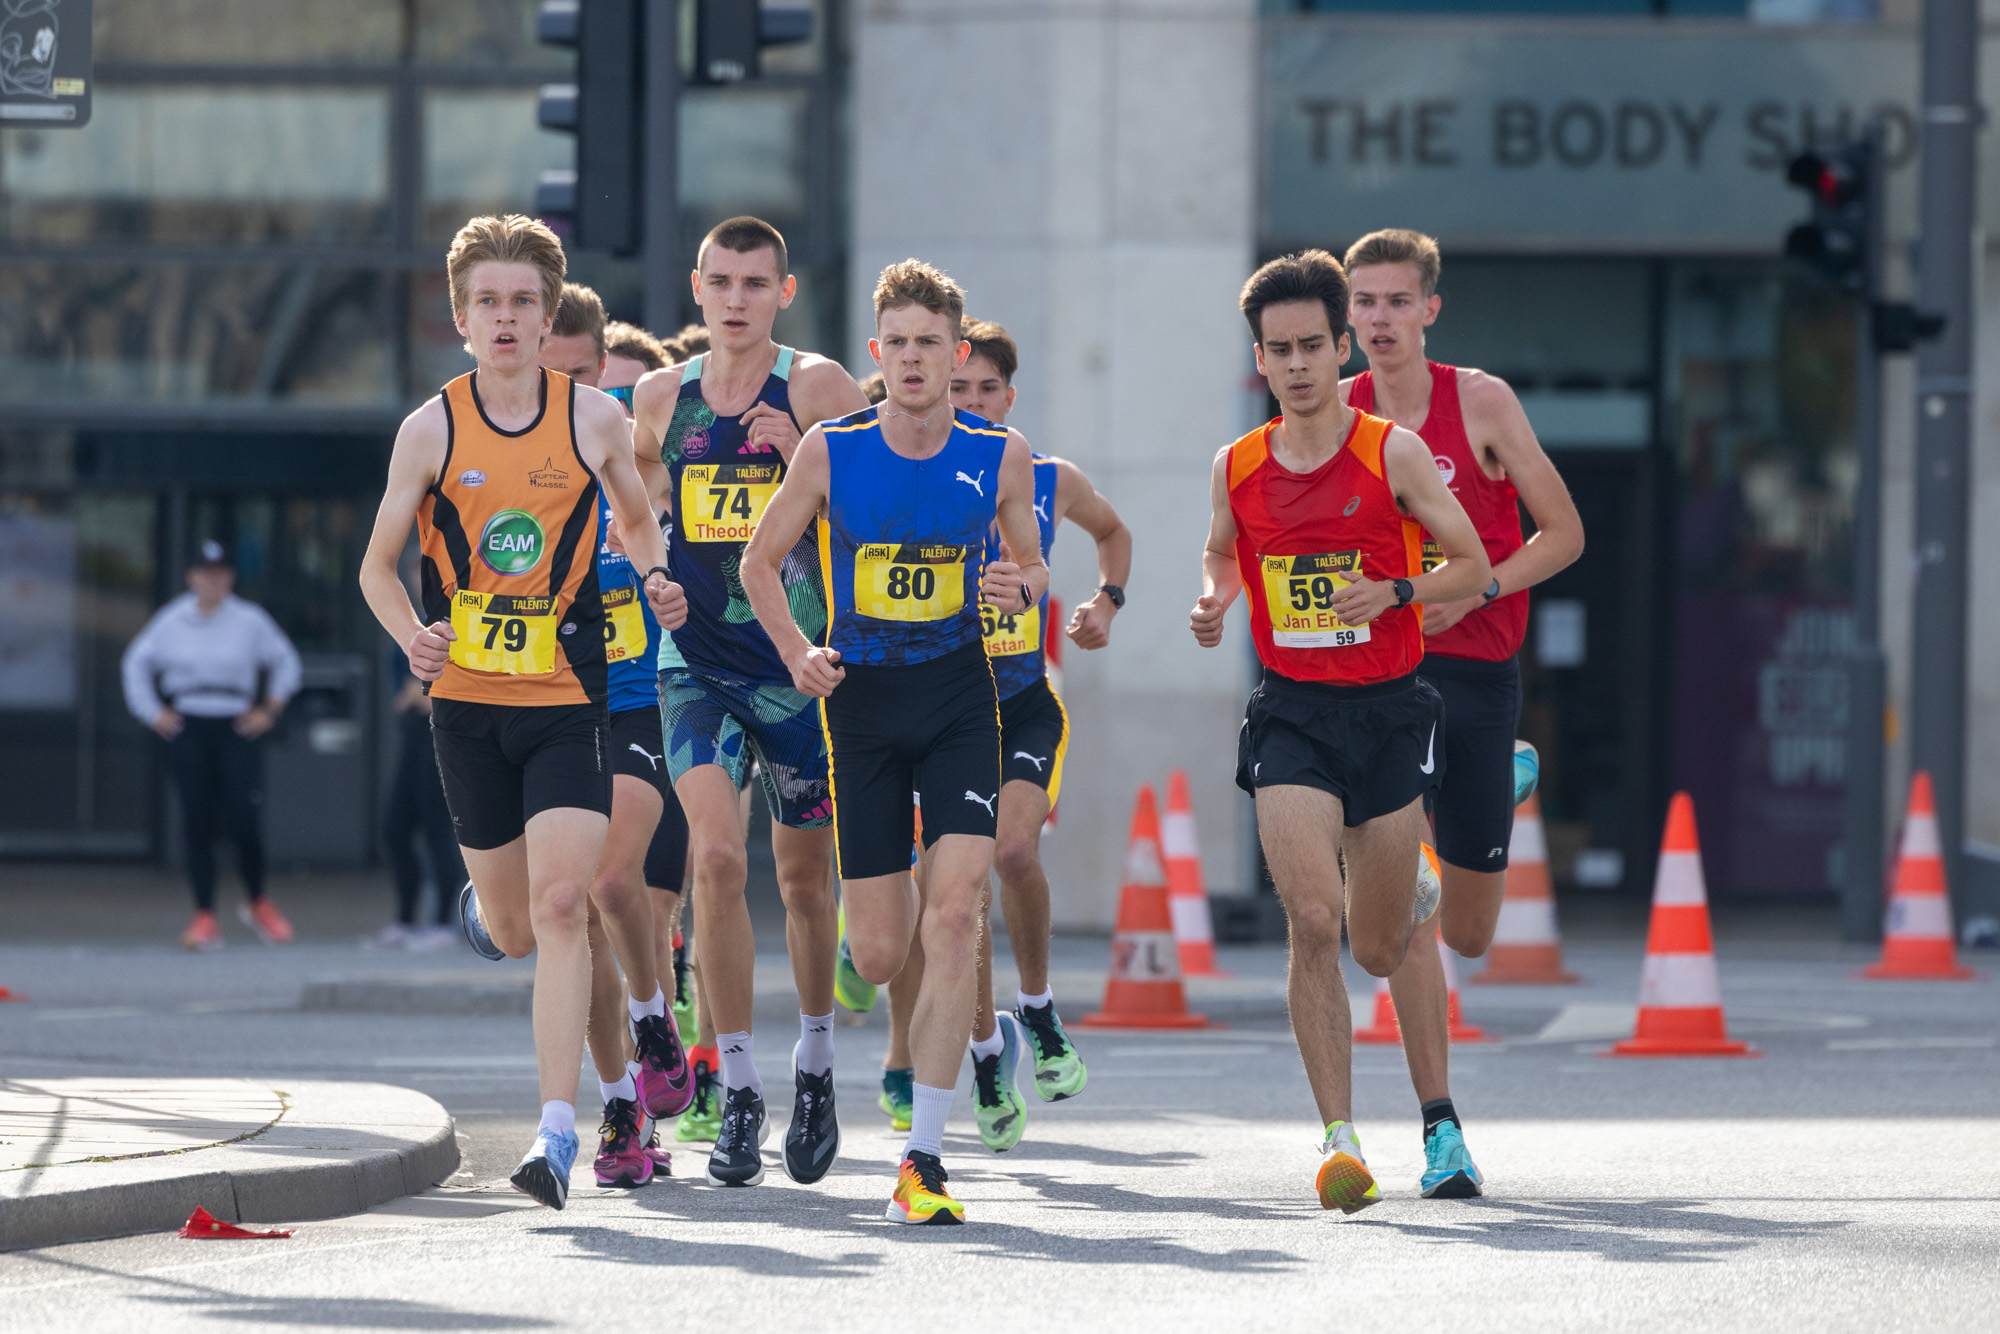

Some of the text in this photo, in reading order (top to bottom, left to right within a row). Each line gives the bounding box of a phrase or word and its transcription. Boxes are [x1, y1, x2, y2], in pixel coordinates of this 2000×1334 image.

[1301, 100, 1459, 167] THE
[1493, 100, 1722, 169] BODY
[736, 467, 771, 479] TALENTS
[709, 488, 752, 520] 74
[488, 533, 535, 552] EAM
[920, 548, 957, 559] TALENTS
[1314, 555, 1352, 568] TALENTS
[887, 566, 935, 600] 80
[600, 589, 631, 605] ALENTS
[1289, 576, 1335, 611] 59
[512, 600, 549, 610] TALENTS
[983, 606, 1017, 639] 64
[1283, 613, 1311, 629] Jan
[481, 616, 527, 652] 79
[1336, 630, 1356, 646] 59
